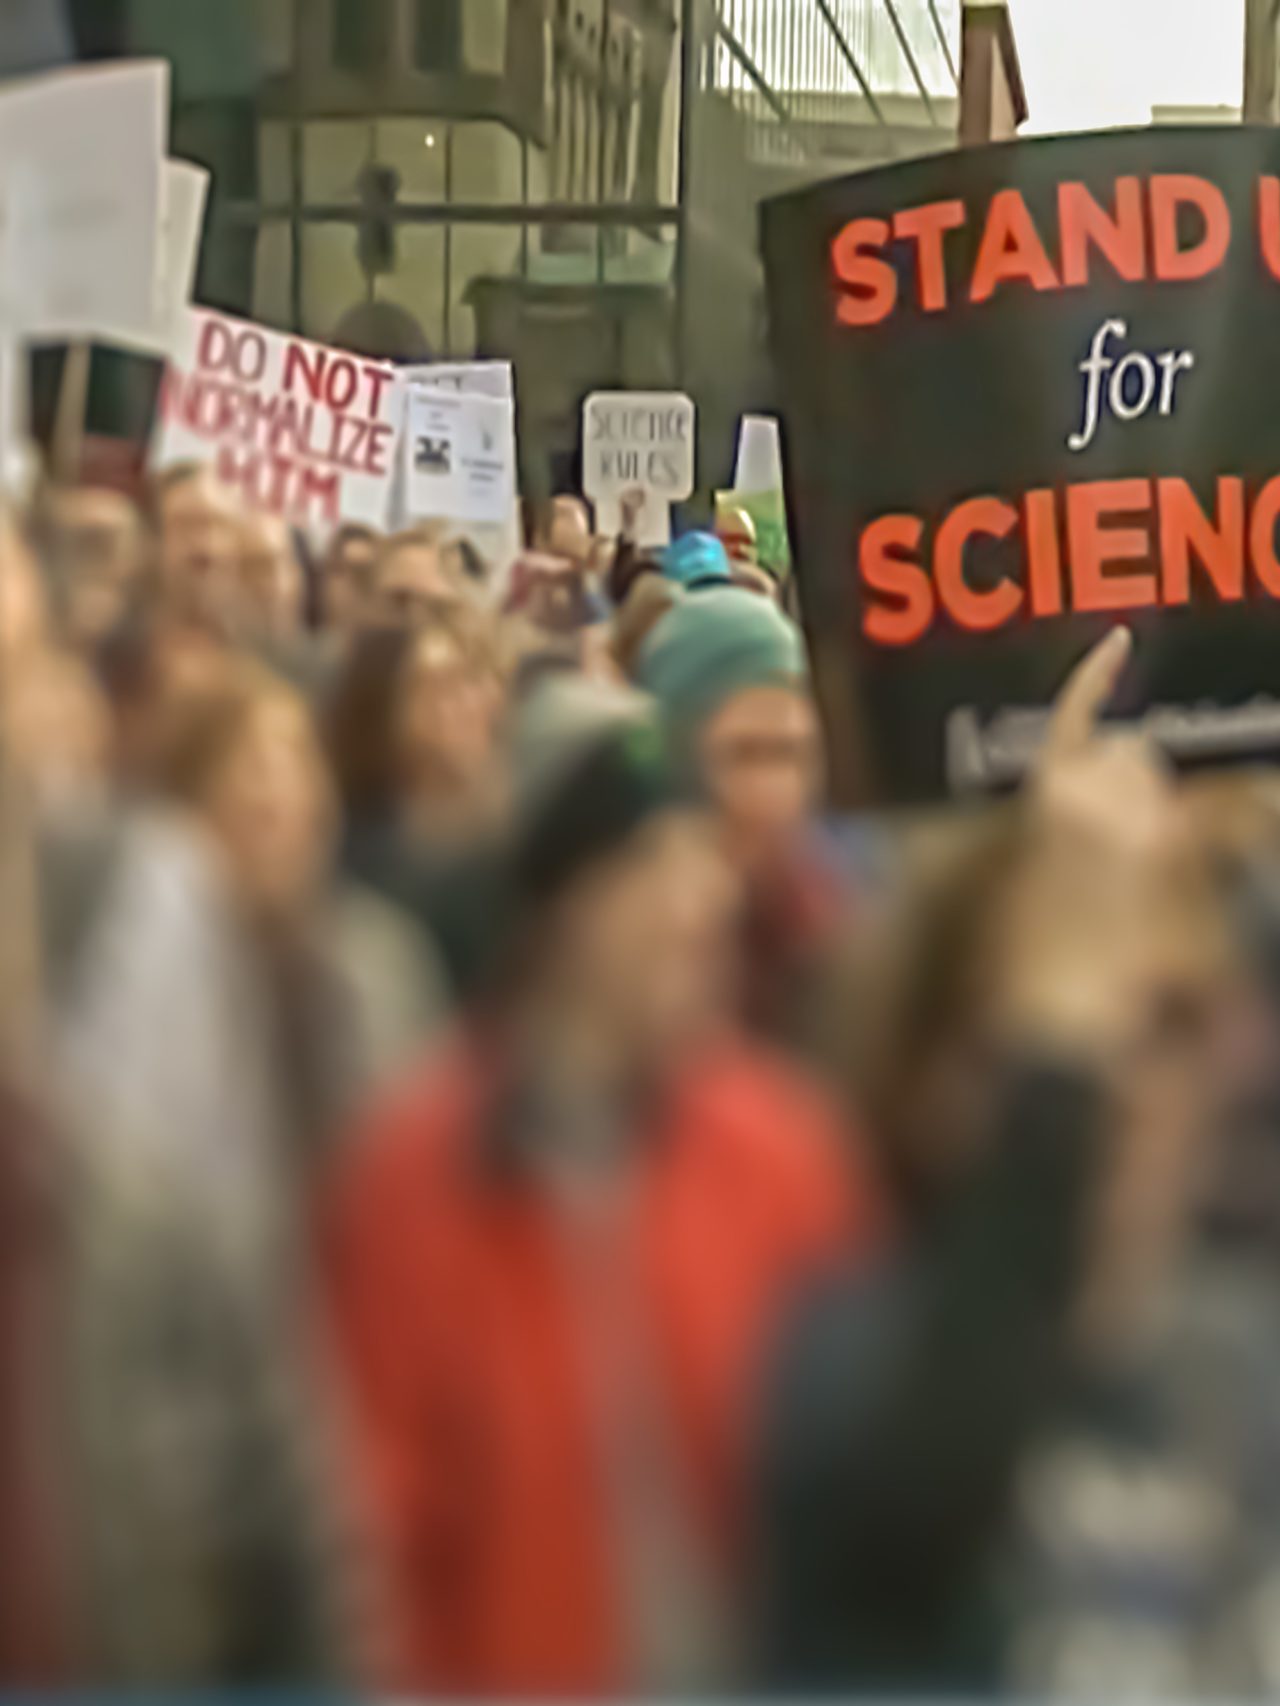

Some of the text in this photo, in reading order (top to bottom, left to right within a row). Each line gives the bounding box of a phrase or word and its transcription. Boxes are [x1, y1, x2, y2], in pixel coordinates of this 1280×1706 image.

[831, 174, 1231, 325] STAND
[159, 368, 394, 477] NORMALIZE
[201, 320, 395, 419] DO NOT
[1067, 319, 1194, 450] for
